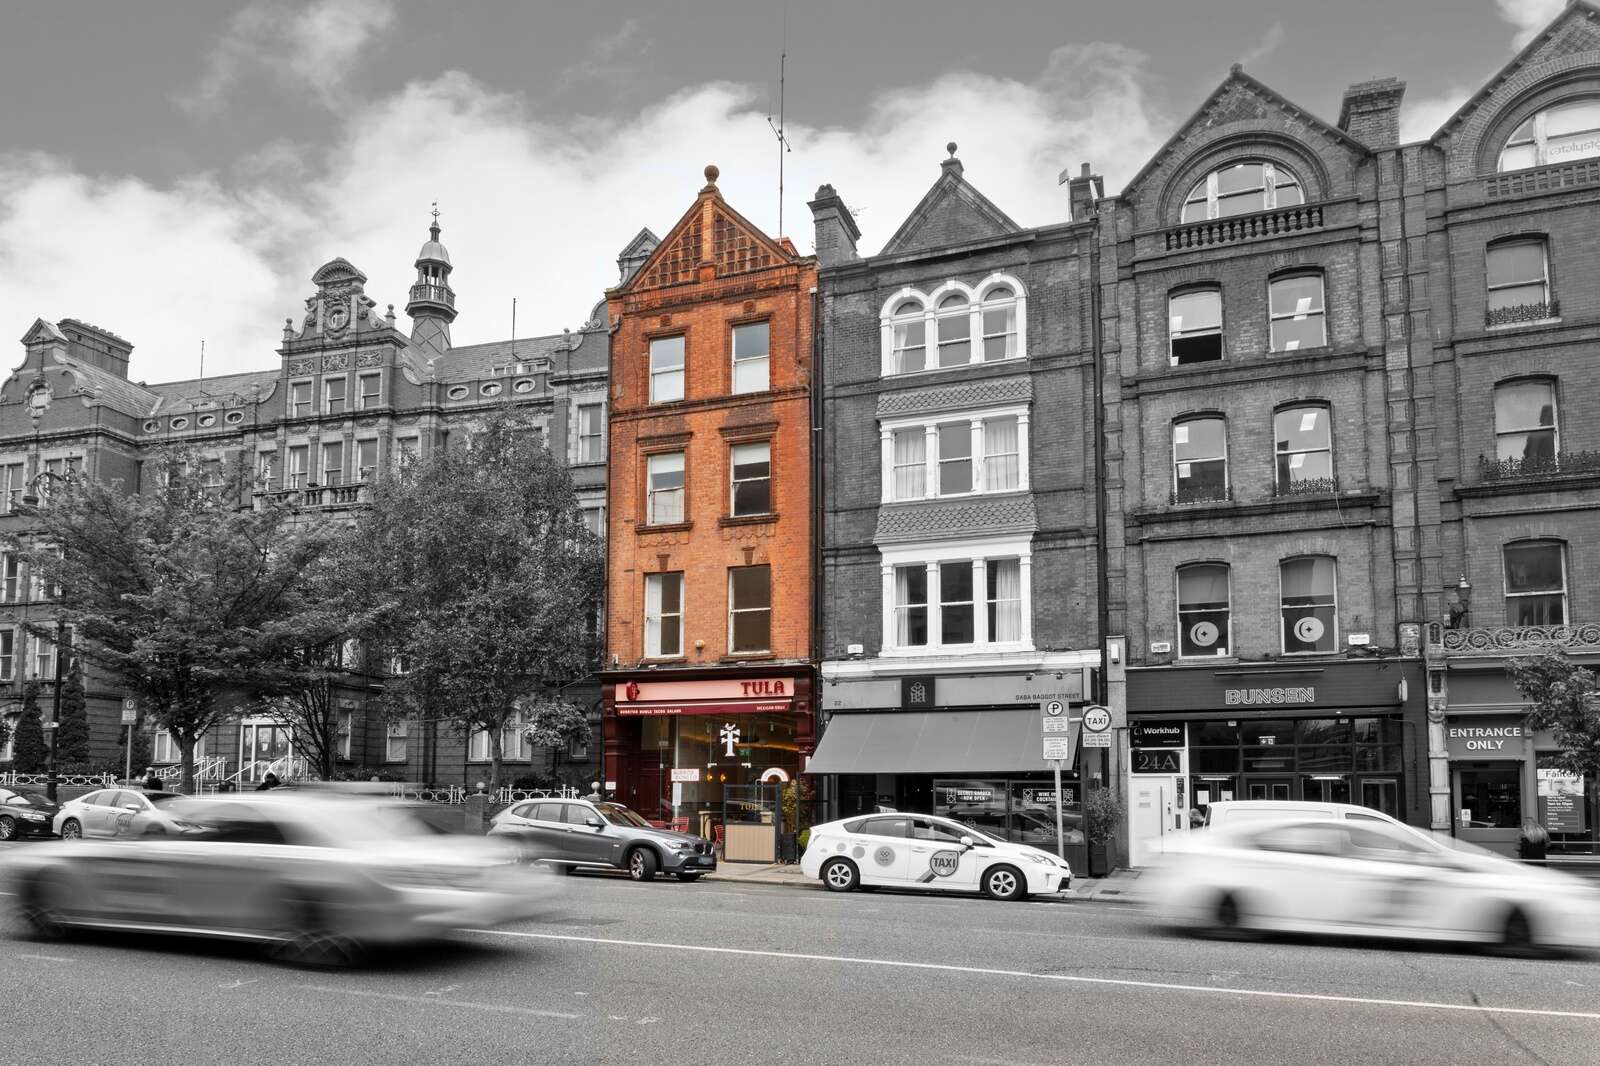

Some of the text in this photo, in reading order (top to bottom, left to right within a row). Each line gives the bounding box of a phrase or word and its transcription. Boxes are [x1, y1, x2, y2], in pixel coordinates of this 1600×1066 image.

[741, 681, 785, 695] TULA
[1225, 687, 1315, 705] BUNSEN
[1052, 704, 1059, 713] P
[1087, 717, 1106, 725] TAXI
[1143, 727, 1180, 735] Workhub
[1449, 727, 1521, 738] ENTRANCE
[1466, 740, 1504, 750] ONLY
[1138, 754, 1178, 769] 24A
[933, 857, 956, 868] TAXI
